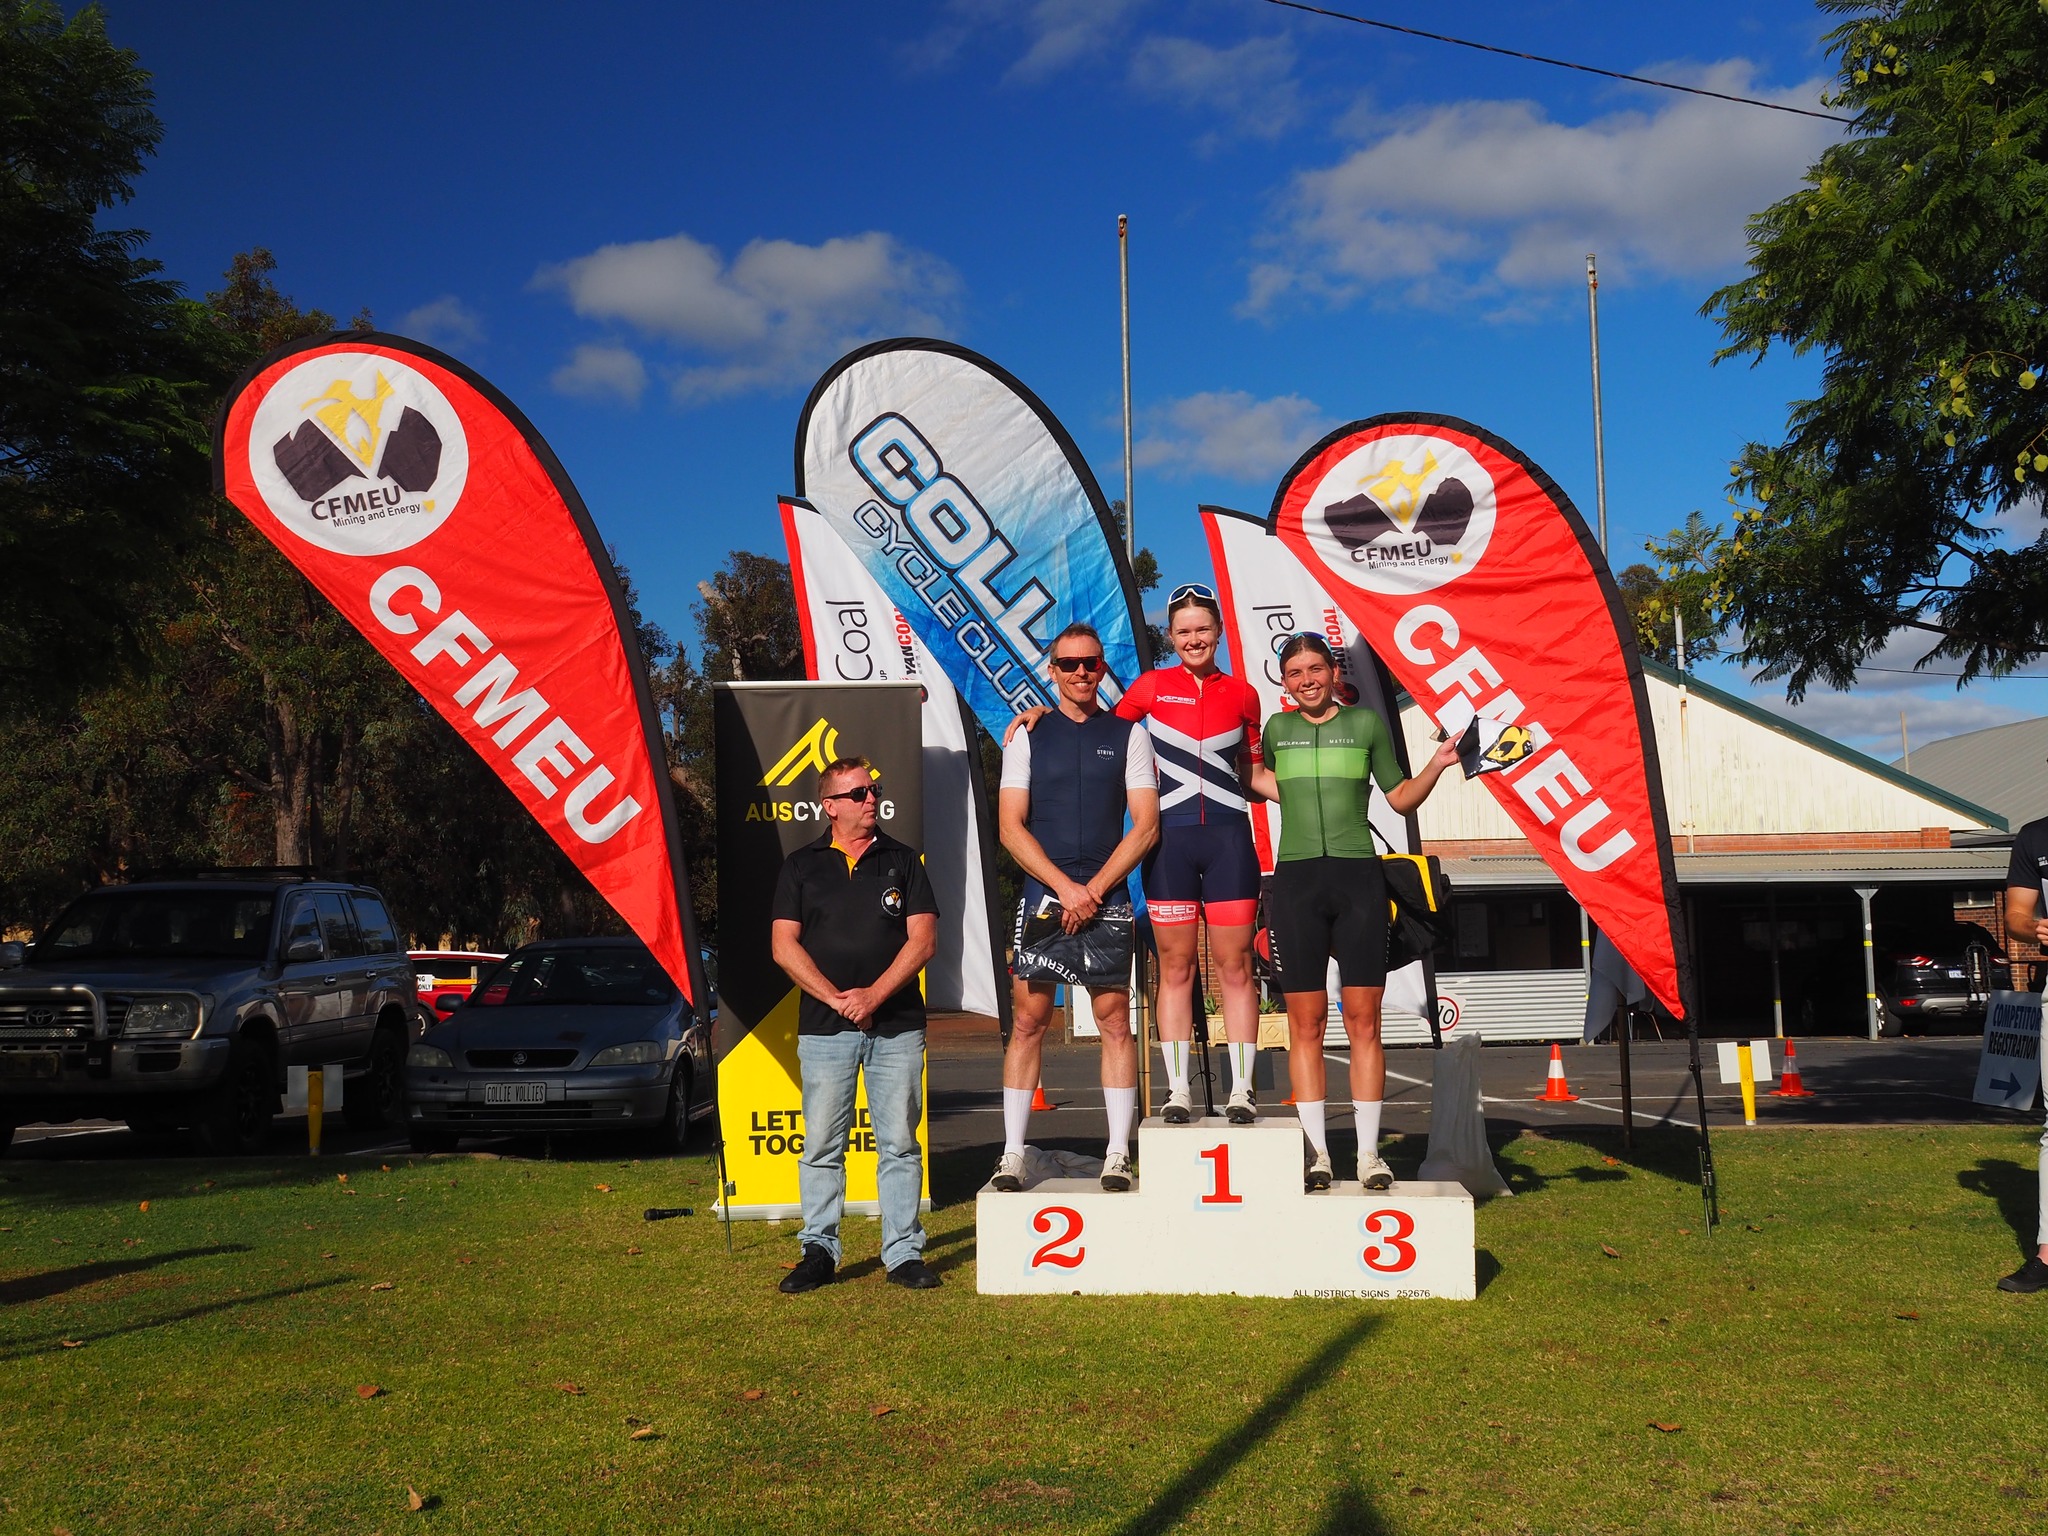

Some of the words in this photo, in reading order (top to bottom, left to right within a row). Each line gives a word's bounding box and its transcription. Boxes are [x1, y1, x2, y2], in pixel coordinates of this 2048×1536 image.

[311, 485, 401, 520] CFMEU
[333, 515, 365, 528] Mining
[368, 509, 386, 521] and
[387, 503, 421, 517] Energy
[848, 411, 1125, 711] COLL
[853, 499, 969, 630] CYCLE
[1351, 539, 1432, 563] CFMEU
[1368, 561, 1398, 570] Mining
[1418, 555, 1449, 567] Energy
[825, 600, 875, 680] Coal
[894, 607, 917, 676] YANCOA
[1323, 606, 1348, 676] ANCOAL
[369, 565, 642, 844] CFMEU
[745, 799, 895, 822] AUSCYG
[1987, 1030, 2040, 1061] REGISTRATION
[487, 1085, 512, 1103] COLLIE
[752, 1110, 803, 1132] LET
[749, 1132, 876, 1156] TOGHE
[1200, 1143, 1243, 1204] 1
[1031, 1206, 1086, 1269] 2
[1363, 1209, 1418, 1273] 3
[1293, 1289, 1309, 1298] ALL
[1314, 1289, 1356, 1298] DISTRICT
[1361, 1289, 1390, 1298] SIGNS
[1396, 1289, 1431, 1298] 252676
